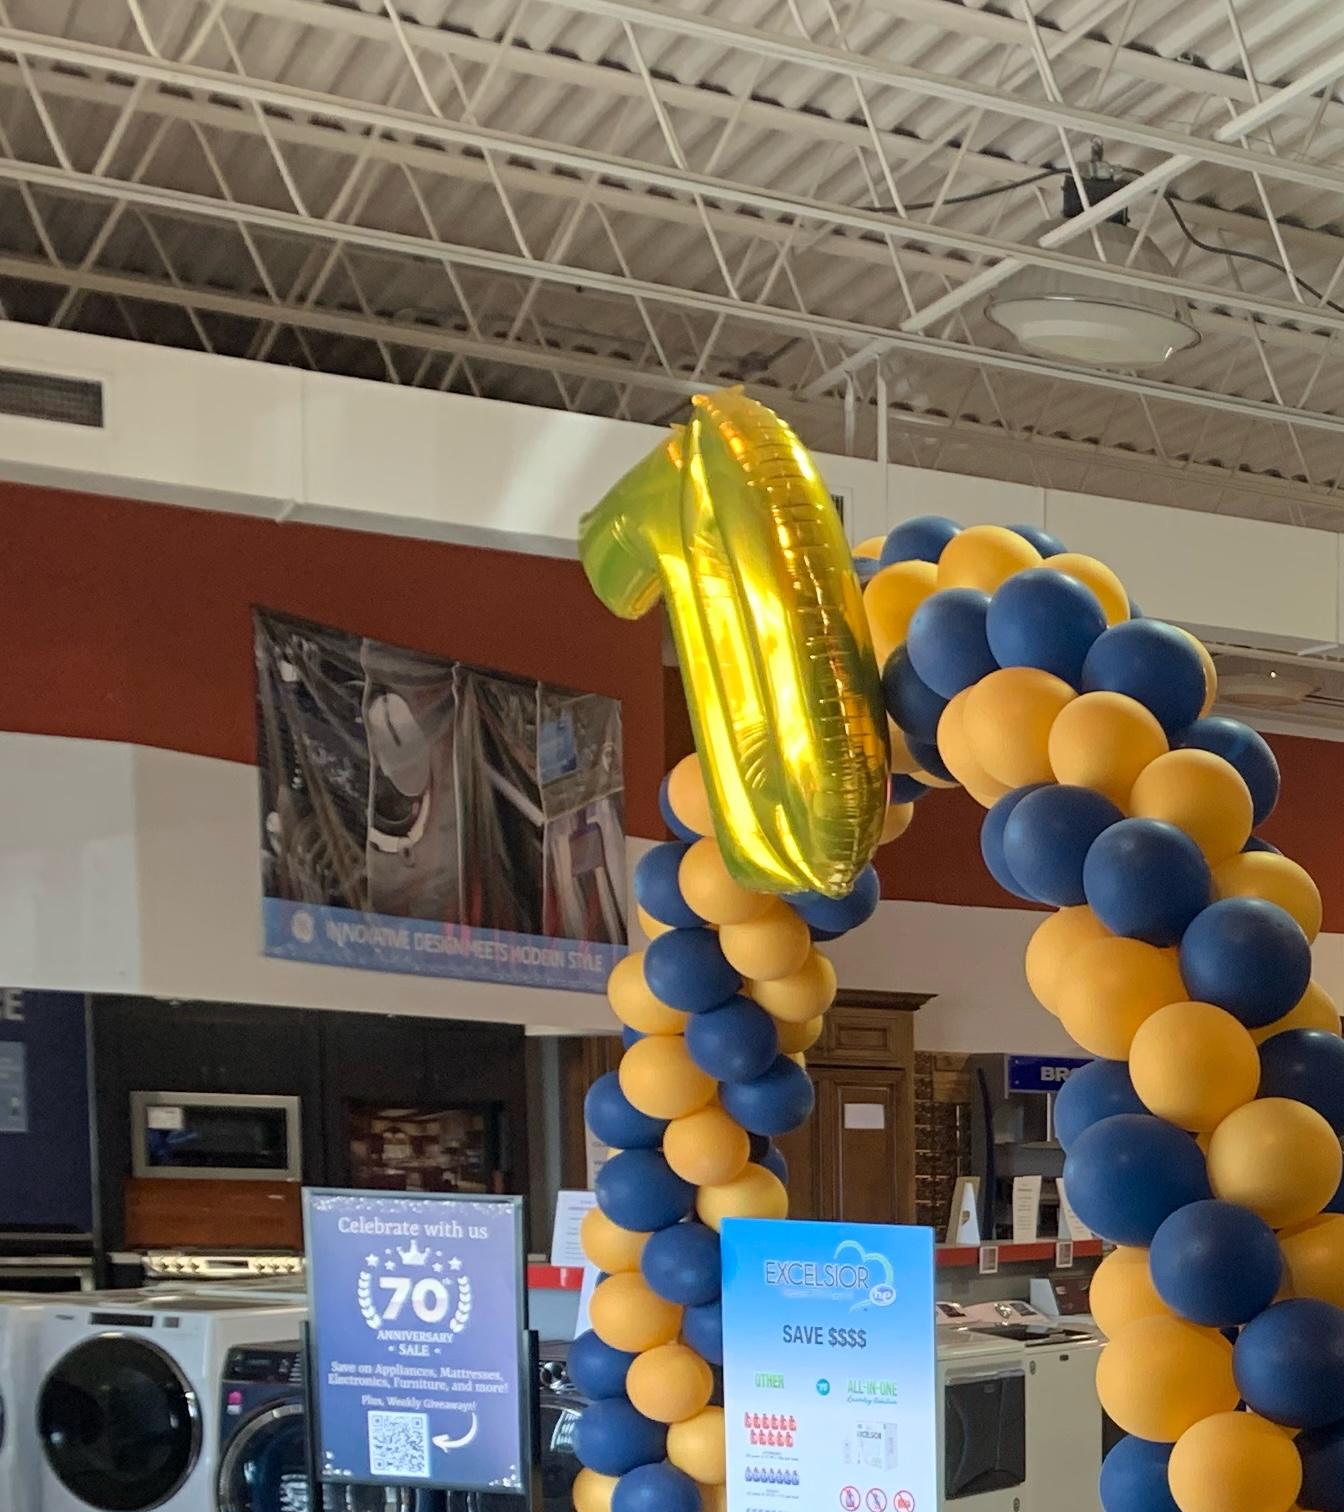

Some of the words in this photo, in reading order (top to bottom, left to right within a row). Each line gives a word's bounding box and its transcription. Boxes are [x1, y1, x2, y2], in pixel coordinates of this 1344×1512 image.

[413, 931, 467, 955] DESIGN
[567, 952, 603, 972] STYLE
[338, 1216, 419, 1236] Celebrate
[424, 1221, 463, 1238] with
[468, 1225, 488, 1239] us
[764, 1260, 869, 1289] EXCELSIOR
[379, 1276, 449, 1324] 70
[377, 1330, 454, 1343] ANNIVERSARY
[782, 1324, 823, 1345] SAVE
[828, 1327, 867, 1349] $$$$
[398, 1344, 430, 1356] SALE
[331, 1361, 355, 1372] Save
[375, 1363, 437, 1378] Appliances,
[328, 1374, 391, 1388] Electronics,
[394, 1377, 449, 1391] Furniture,
[451, 1380, 473, 1391] and
[755, 1374, 785, 1388] OTHER
[848, 1380, 898, 1397] ALL-IN-ONE
[387, 1396, 421, 1410] Weekly
